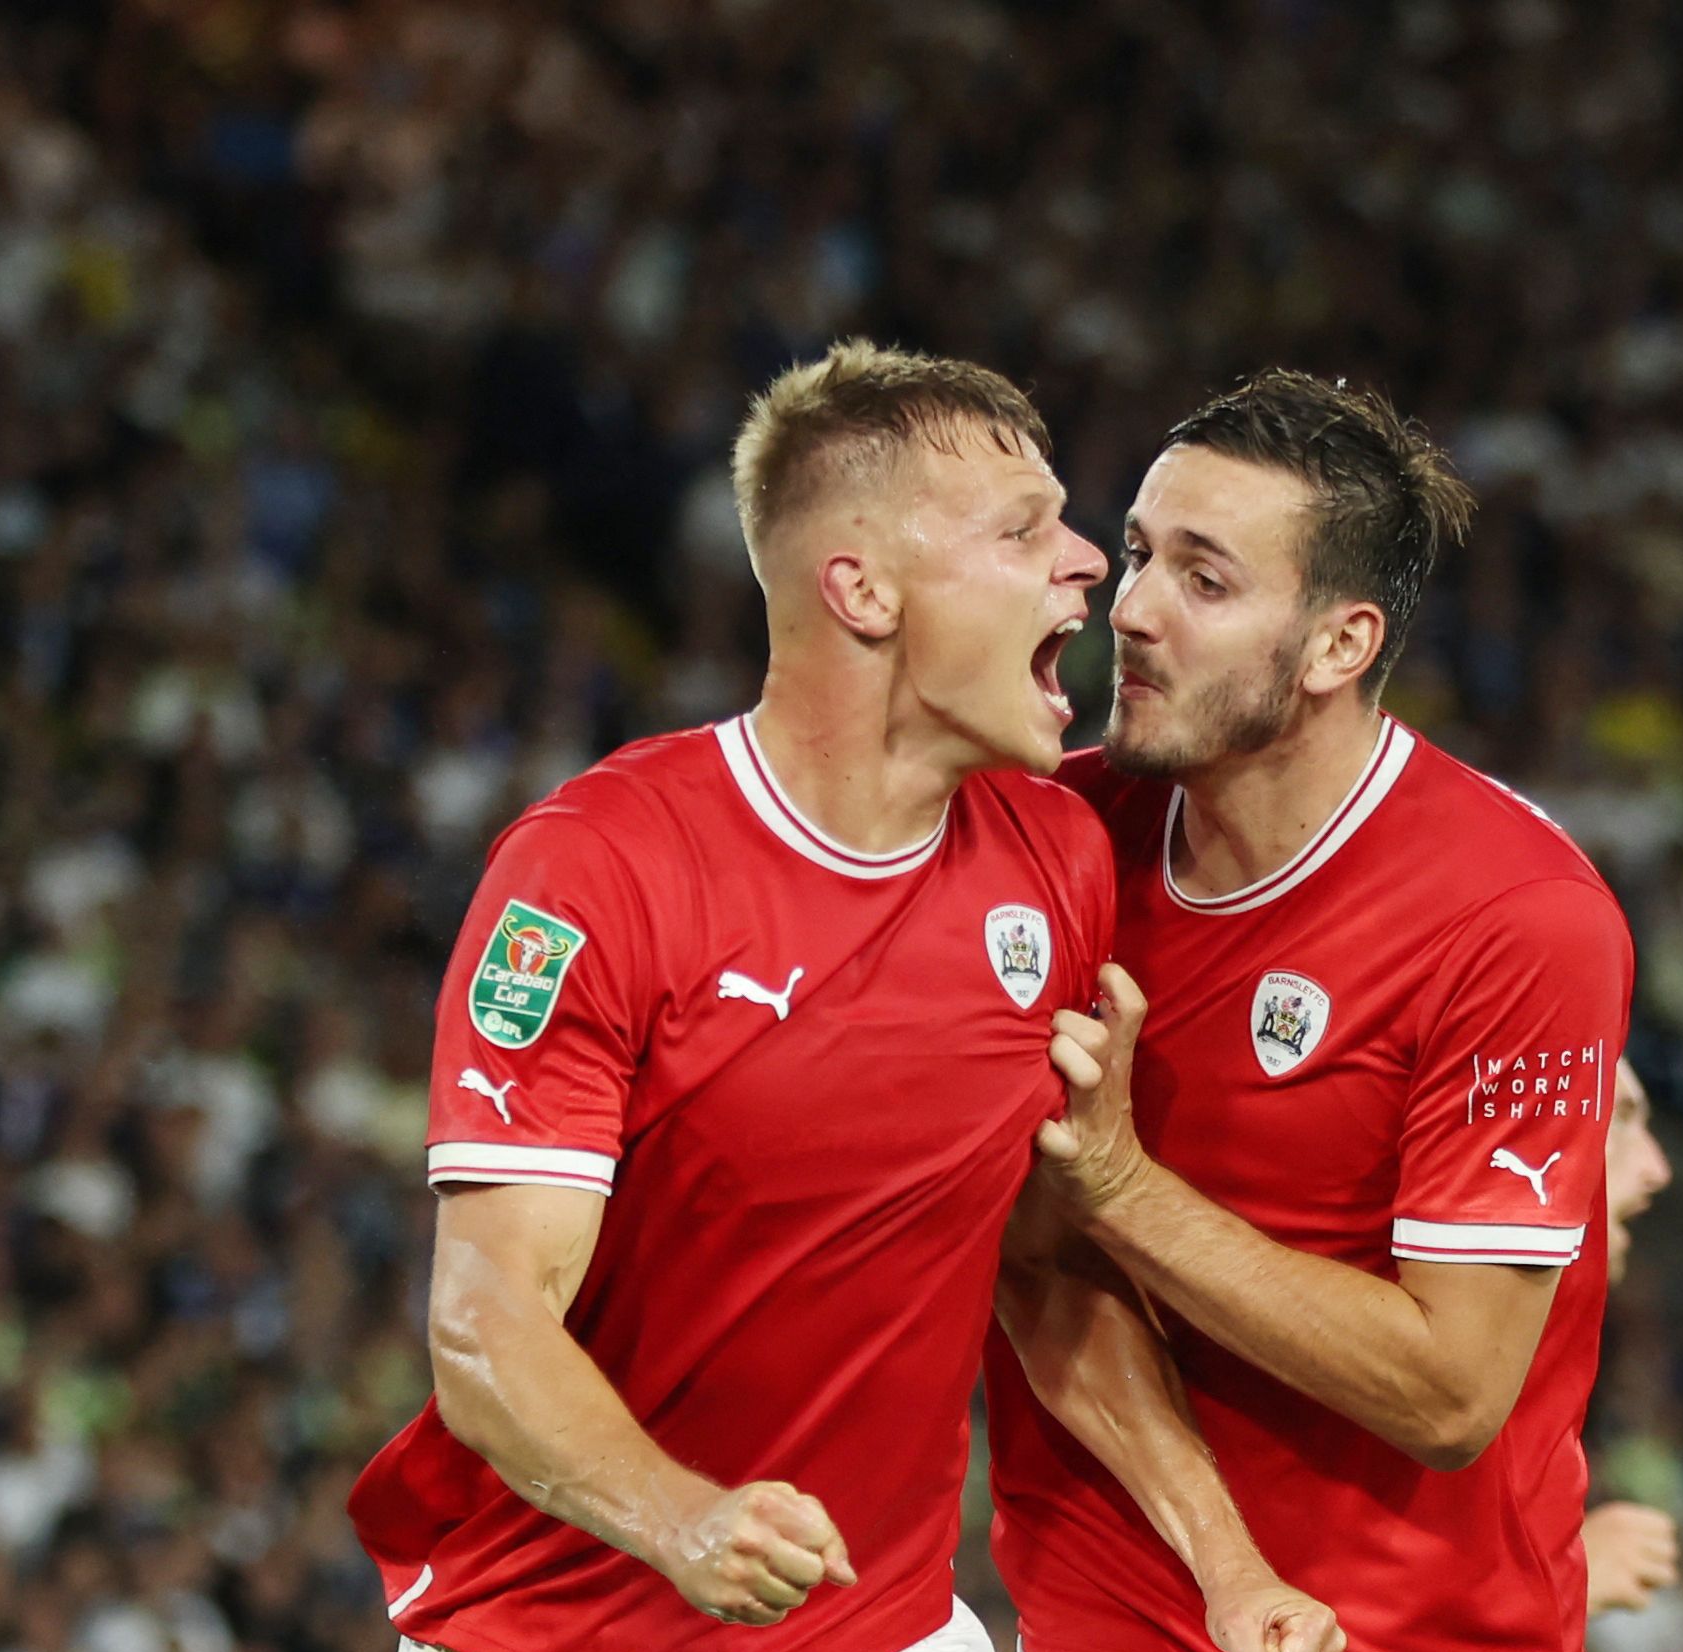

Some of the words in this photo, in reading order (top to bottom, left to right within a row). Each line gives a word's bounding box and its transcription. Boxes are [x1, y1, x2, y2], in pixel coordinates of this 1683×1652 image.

[990, 911, 1030, 922] BARNSLEY
[482, 963, 556, 992] Carabao
[494, 984, 530, 1007] Cup
[1268, 976, 1314, 996] BARNSLEY
[1315, 994, 1325, 1006] FC
[502, 1020, 522, 1040] EFL
[1487, 1046, 1594, 1075] MATCH
[1482, 1074, 1570, 1096] WORN
[1483, 1099, 1591, 1119] SHIRT
